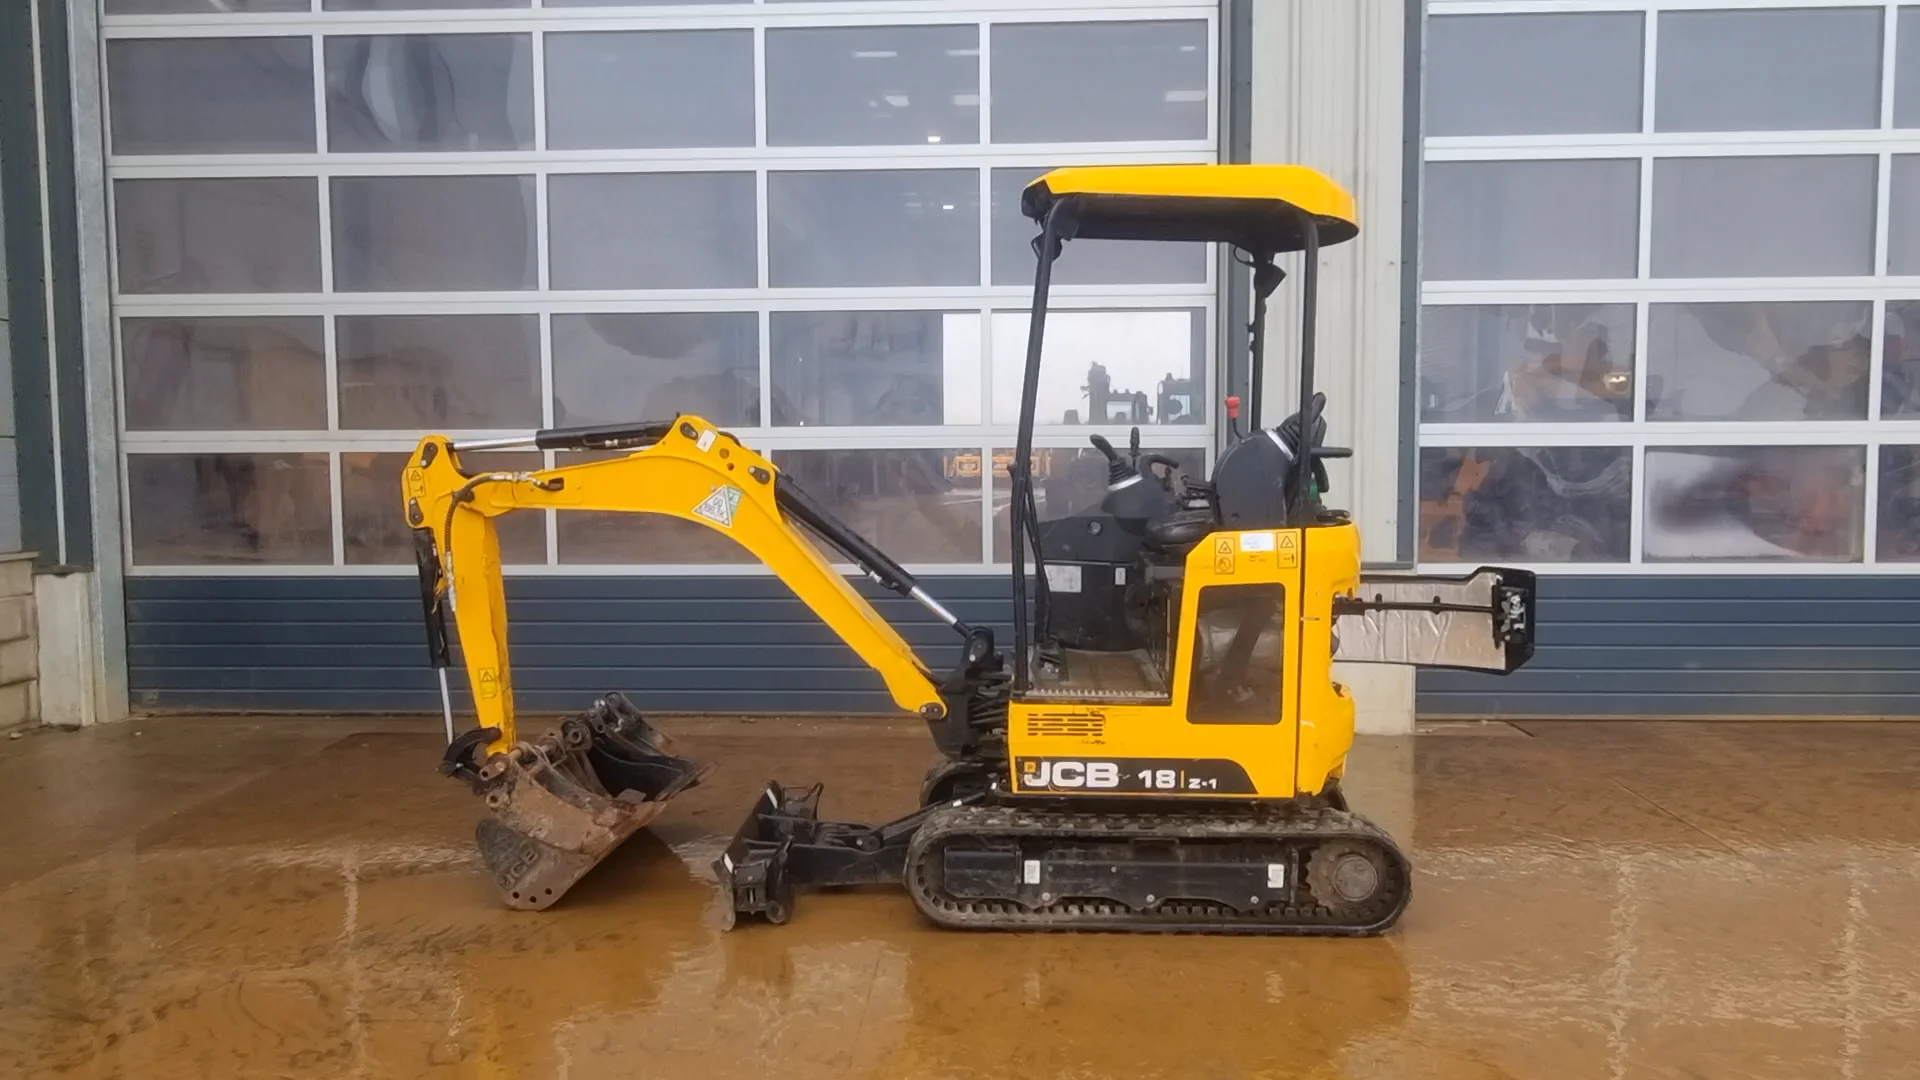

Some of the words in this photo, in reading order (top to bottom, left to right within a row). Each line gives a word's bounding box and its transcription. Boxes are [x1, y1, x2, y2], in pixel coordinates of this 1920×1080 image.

[1024, 761, 1119, 788] JCB
[1138, 769, 1176, 789] 18
[498, 846, 539, 891] JCB
